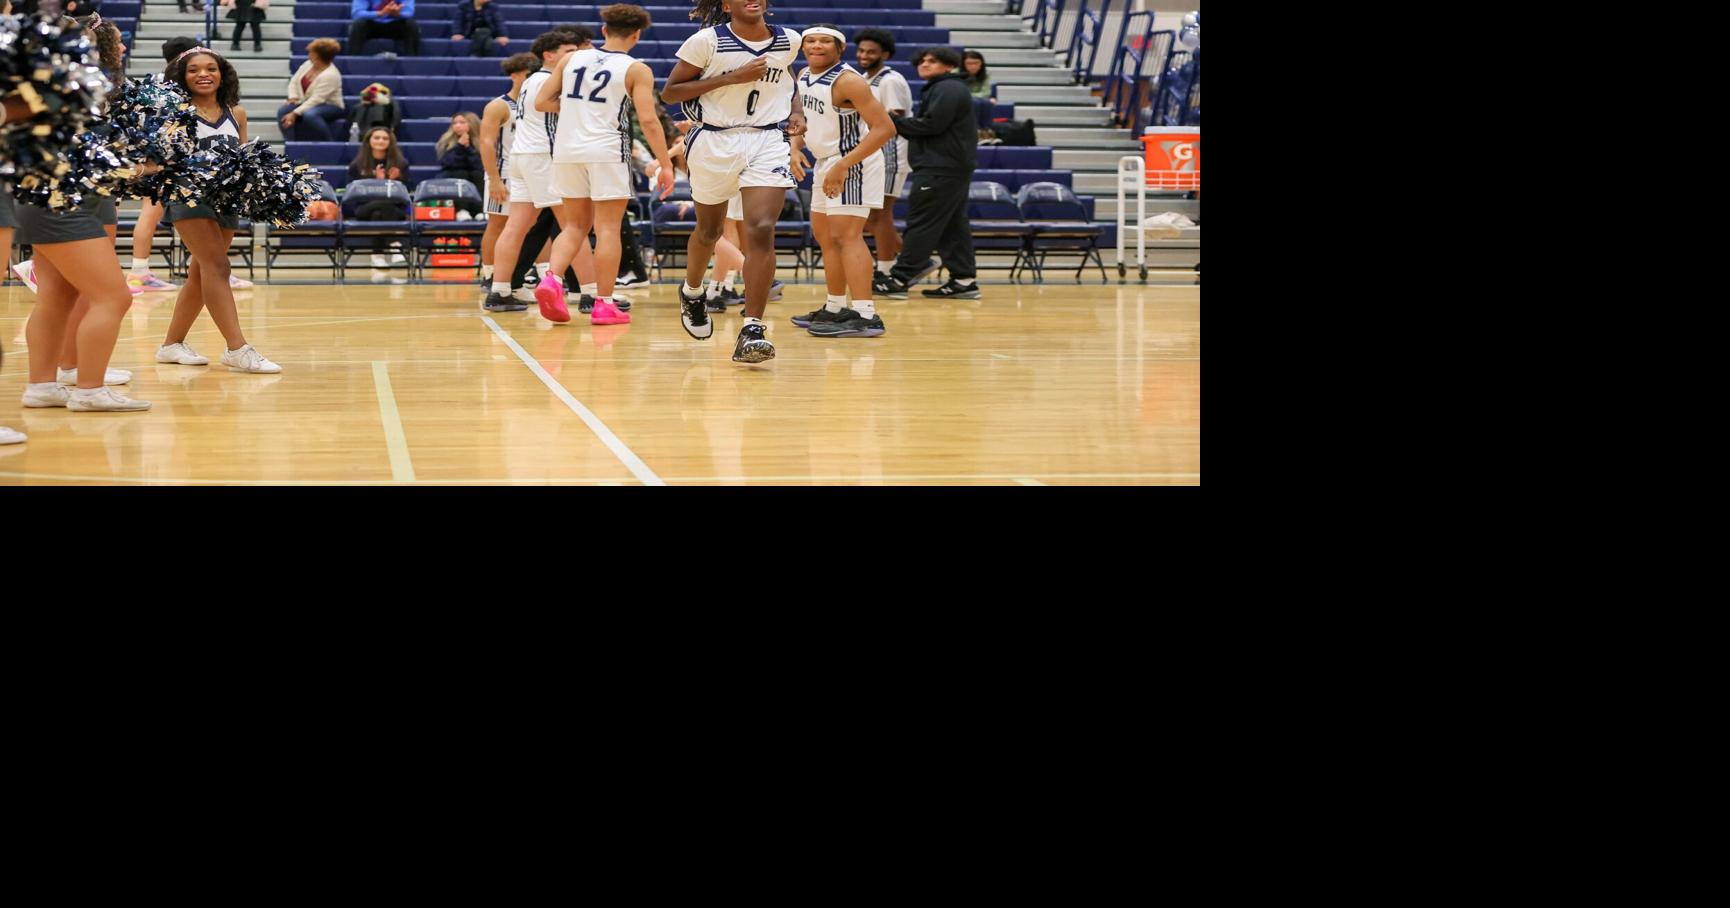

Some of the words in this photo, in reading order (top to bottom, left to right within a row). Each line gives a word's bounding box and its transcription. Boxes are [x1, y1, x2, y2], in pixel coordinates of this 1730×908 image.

[567, 66, 611, 103] 12
[747, 89, 760, 116] 0
[1173, 143, 1193, 160] G
[429, 209, 441, 219] G
